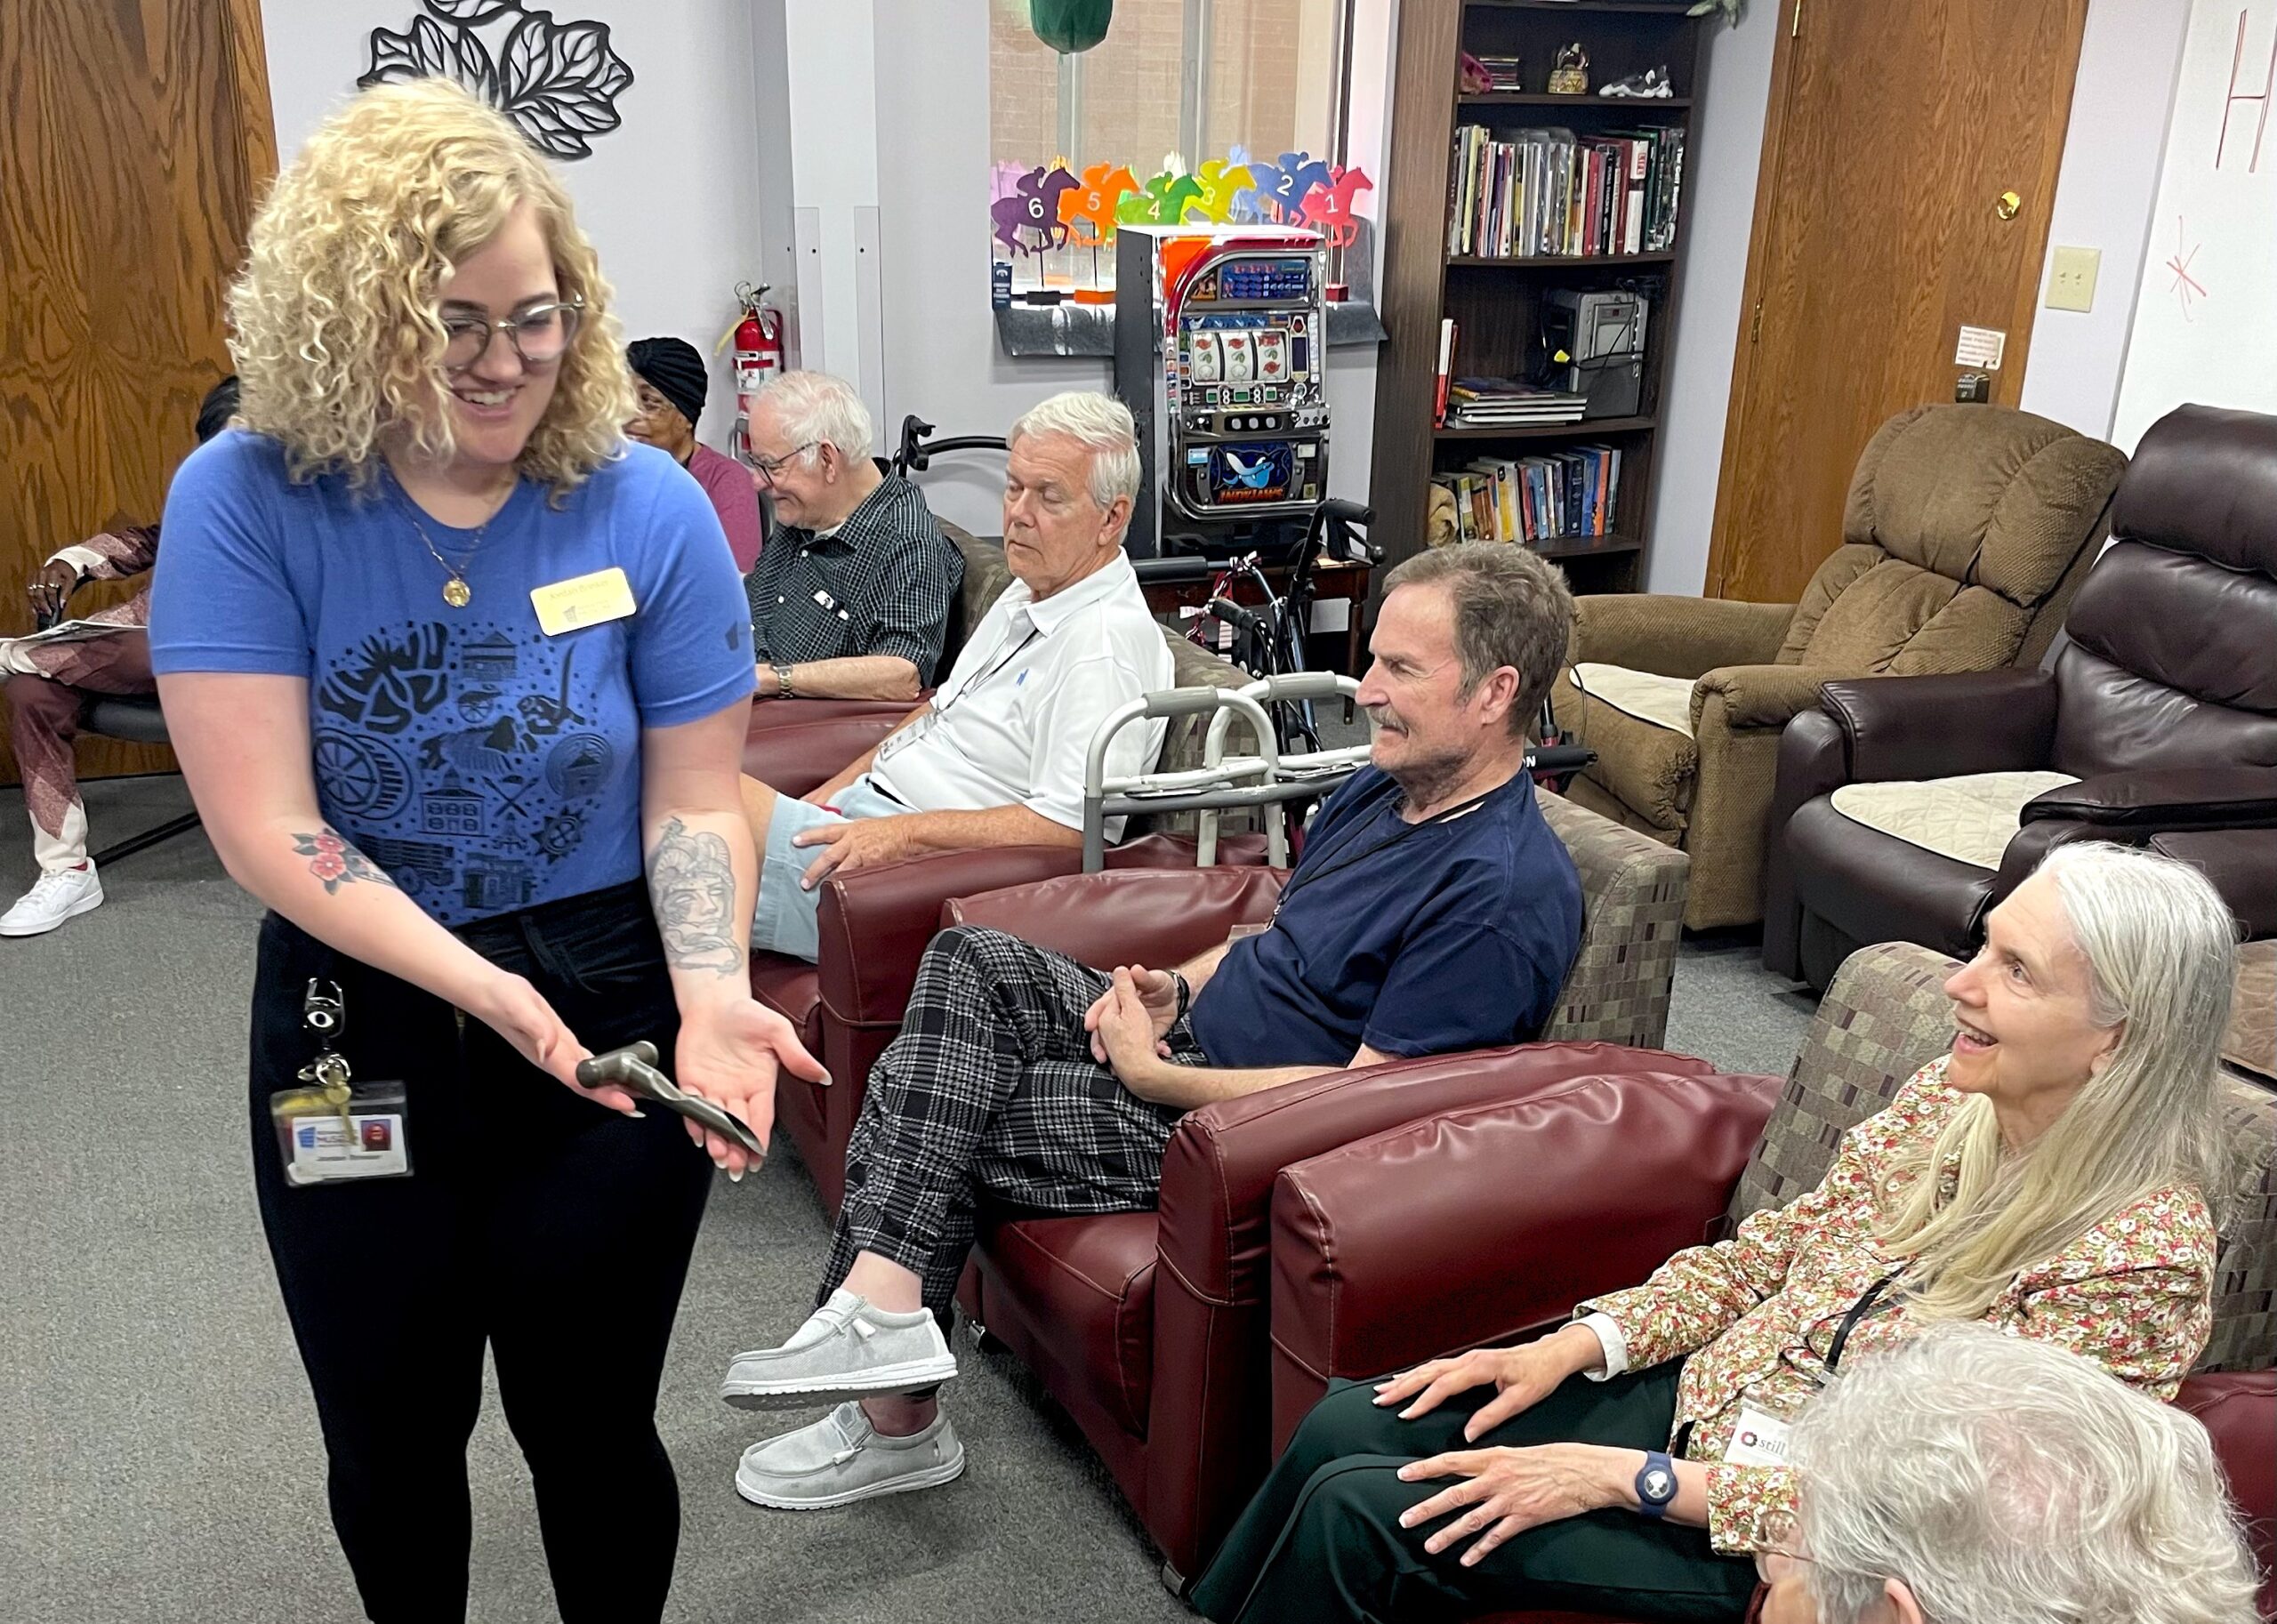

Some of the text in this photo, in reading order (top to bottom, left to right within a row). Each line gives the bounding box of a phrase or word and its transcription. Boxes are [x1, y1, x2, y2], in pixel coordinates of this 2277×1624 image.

[1276, 174, 1294, 196] 2
[1027, 197, 1044, 219] 6
[1087, 192, 1101, 212] 5
[1147, 199, 1161, 220] 4
[1324, 194, 1339, 213] 1
[1758, 1439, 1786, 1456] still
